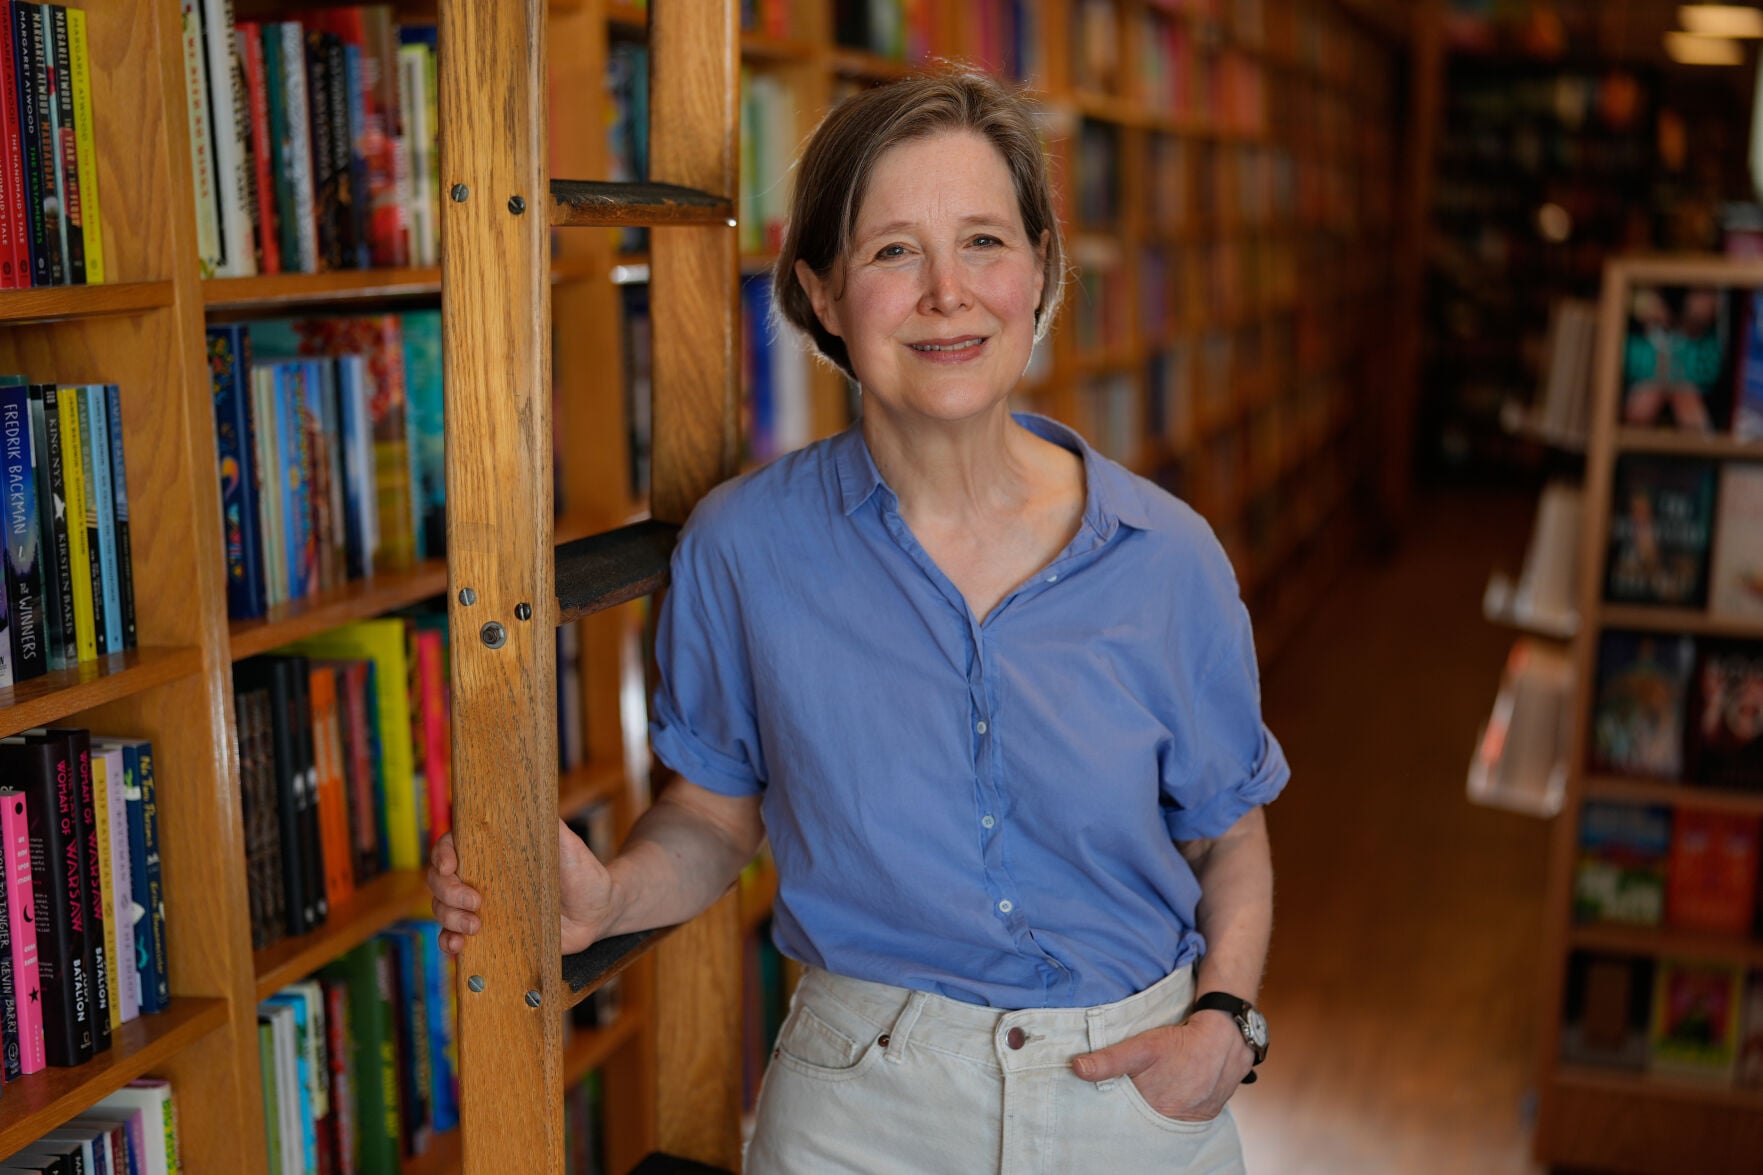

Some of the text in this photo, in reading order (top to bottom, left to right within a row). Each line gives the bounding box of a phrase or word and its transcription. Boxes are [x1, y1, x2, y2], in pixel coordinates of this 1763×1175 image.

[2, 6, 15, 125] MARGARET ATWOOD
[20, 10, 34, 134] MARGARET ATWOOD
[33, 13, 49, 115] MARGARET ATWOOD
[56, 11, 72, 110] MARGARET ATWOOD
[74, 18, 88, 142] MARGARET ATWOOD
[65, 135, 76, 161] YEAR
[14, 154, 22, 218] HANDMAID'S
[32, 172, 44, 245] TESTAMENTS
[70, 195, 82, 226] FLOOD
[78, 396, 88, 438] JAMES
[4, 404, 26, 534] FREDRIK BACKMAN
[48, 418, 62, 487] KING NYX
[58, 532, 73, 635] KIRSTEN BAKIS
[19, 595, 36, 660] WINNERS
[141, 756, 151, 776] No
[142, 777, 154, 802] Two
[57, 760, 84, 932] WOMAN OF WARSAW
[80, 751, 103, 920] WOMAN OF WARSAW
[0, 901, 10, 949] TANGIER
[1, 962, 16, 1033] KEVIN BARRY
[73, 959, 85, 1022] BATALION
[96, 947, 107, 1009] BATALION
